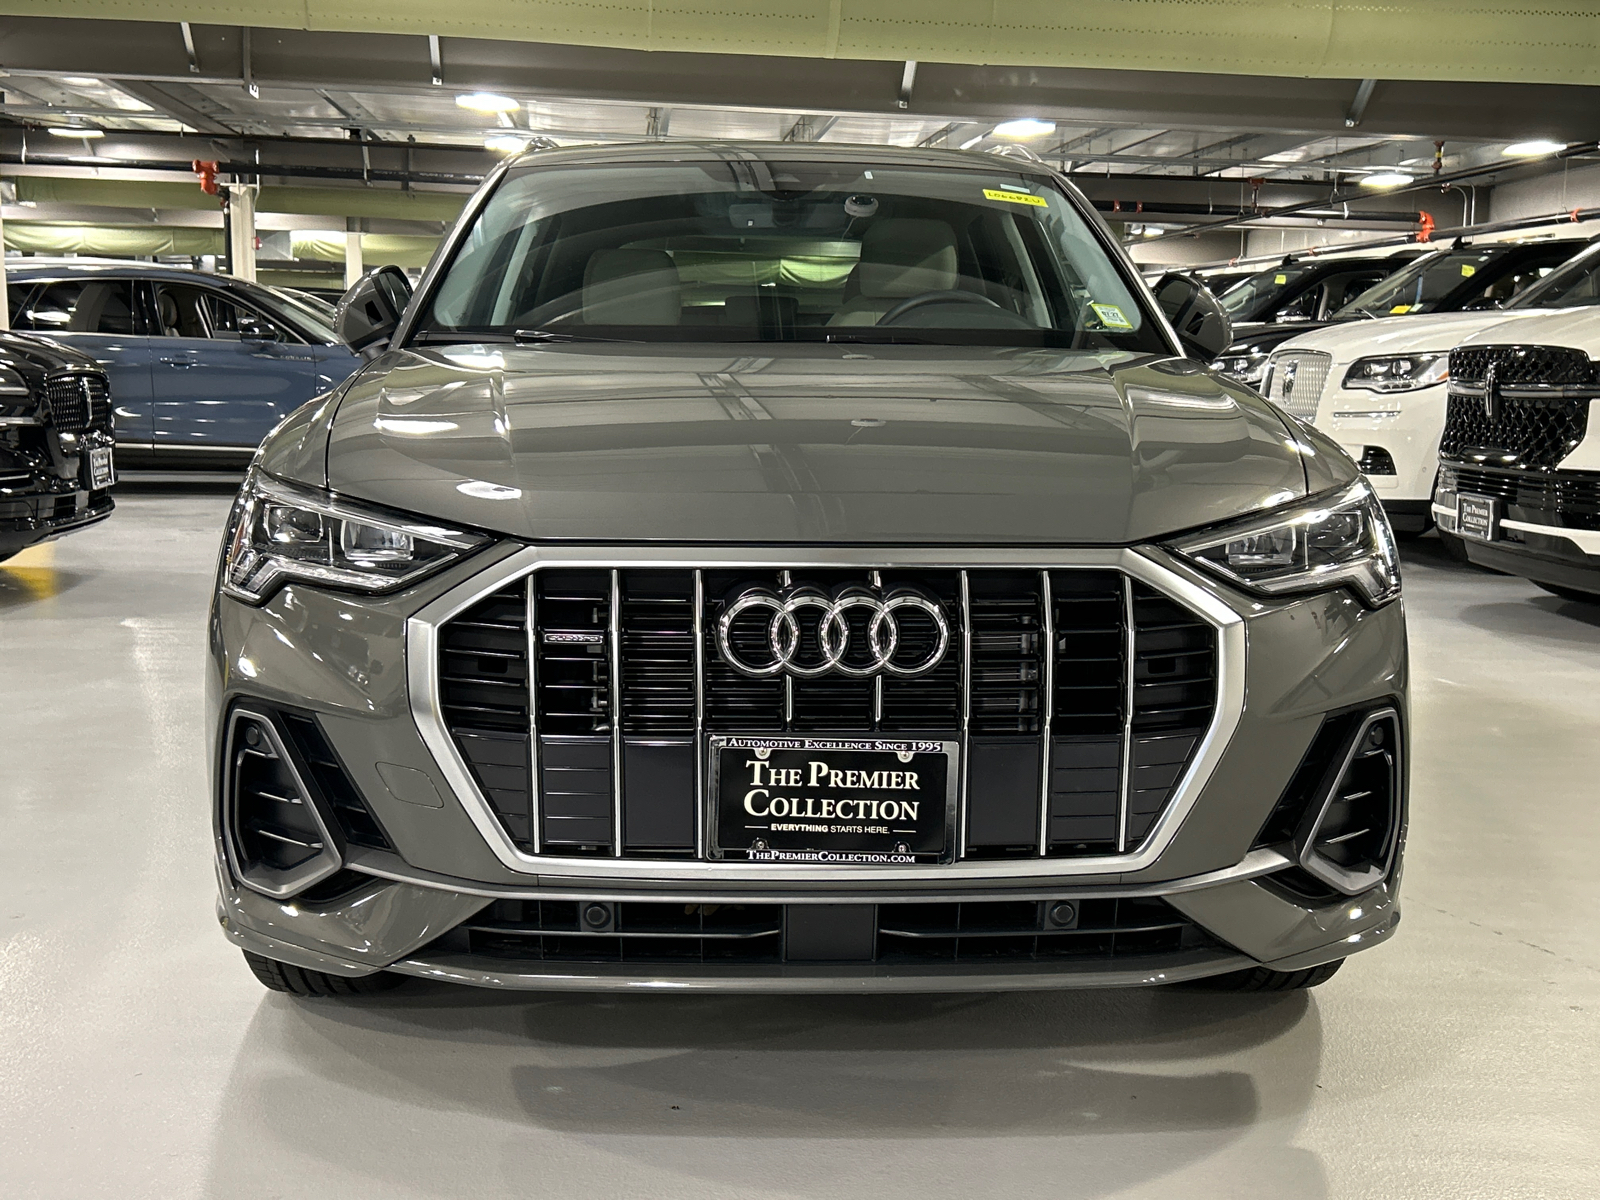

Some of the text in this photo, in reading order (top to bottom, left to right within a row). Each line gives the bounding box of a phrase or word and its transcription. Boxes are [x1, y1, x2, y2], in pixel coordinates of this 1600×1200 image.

[728, 738, 941, 752] AUTOMOTIVE EXCELLENCE SINCE 1995
[745, 760, 920, 790] THE PREMIER
[744, 789, 920, 820] COLLECTION
[770, 823, 829, 833] EVERYTHING
[830, 825, 863, 834] STARTS
